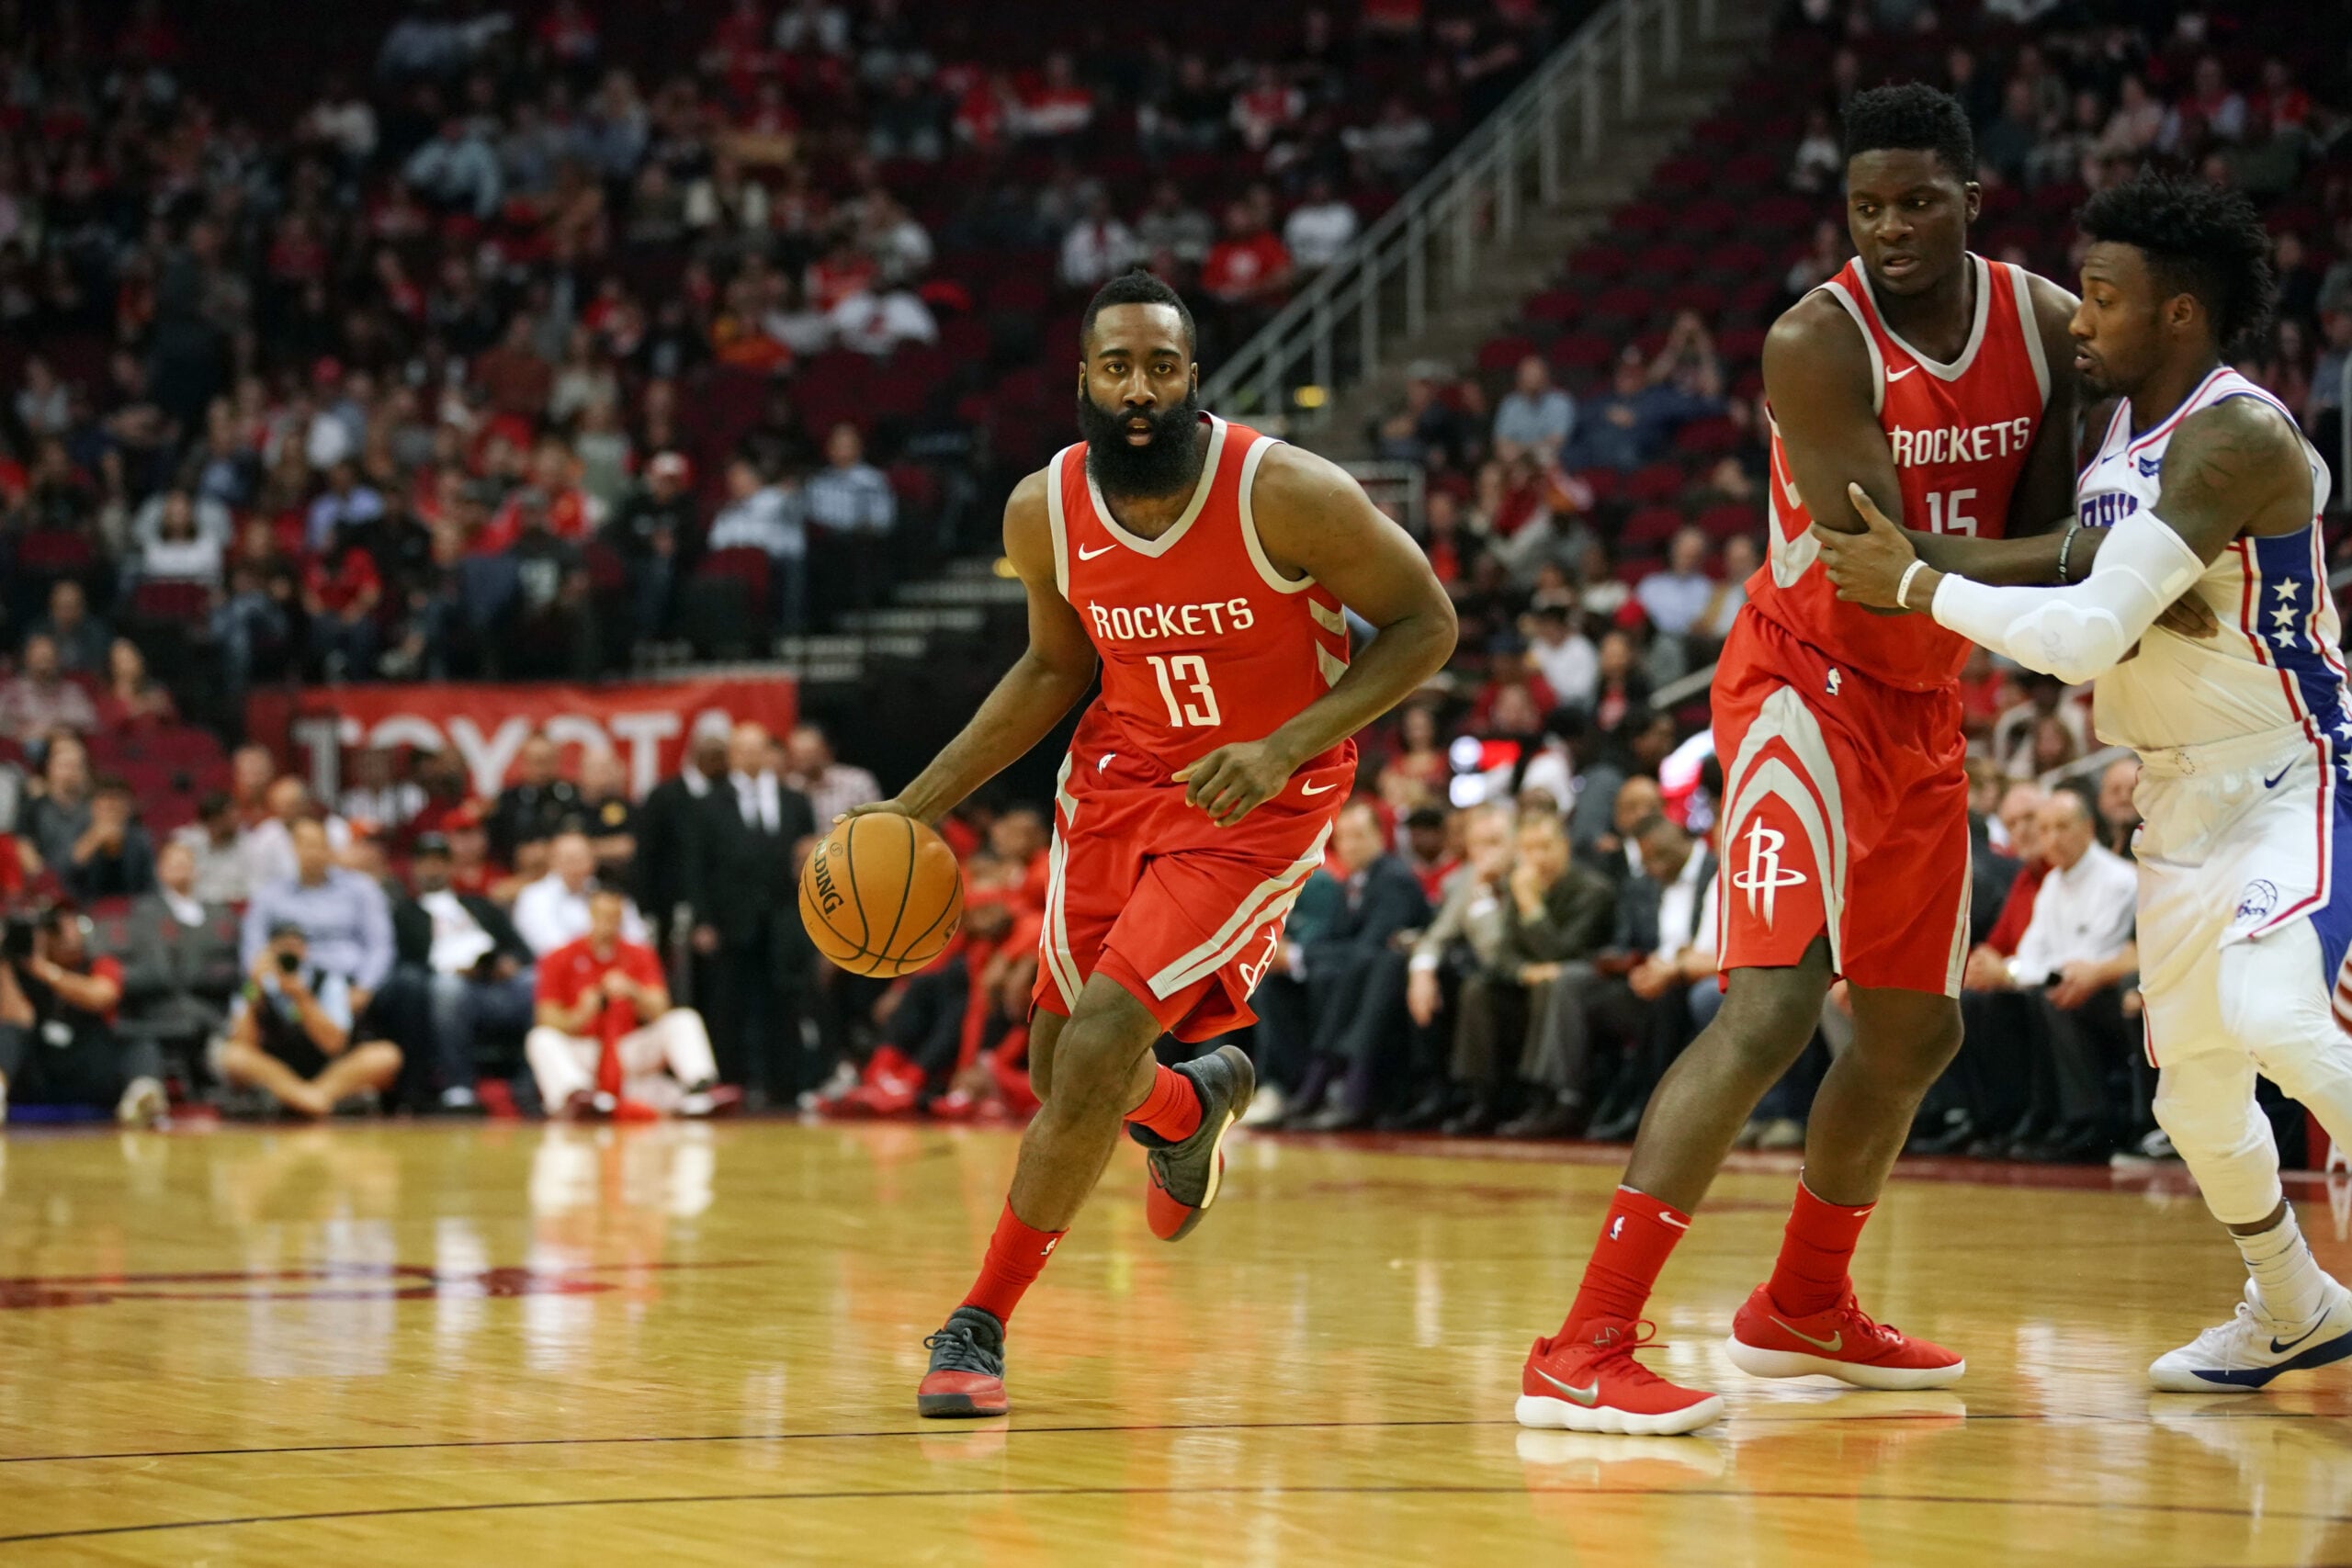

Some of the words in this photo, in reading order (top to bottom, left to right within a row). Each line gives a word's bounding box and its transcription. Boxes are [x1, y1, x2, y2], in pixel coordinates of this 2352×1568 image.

[1887, 416, 2031, 468] ROCKETS
[1925, 488, 1978, 536] 15
[1088, 597, 1254, 640] ROCKETS
[1146, 655, 1221, 728] 13
[290, 709, 734, 801] TYT
